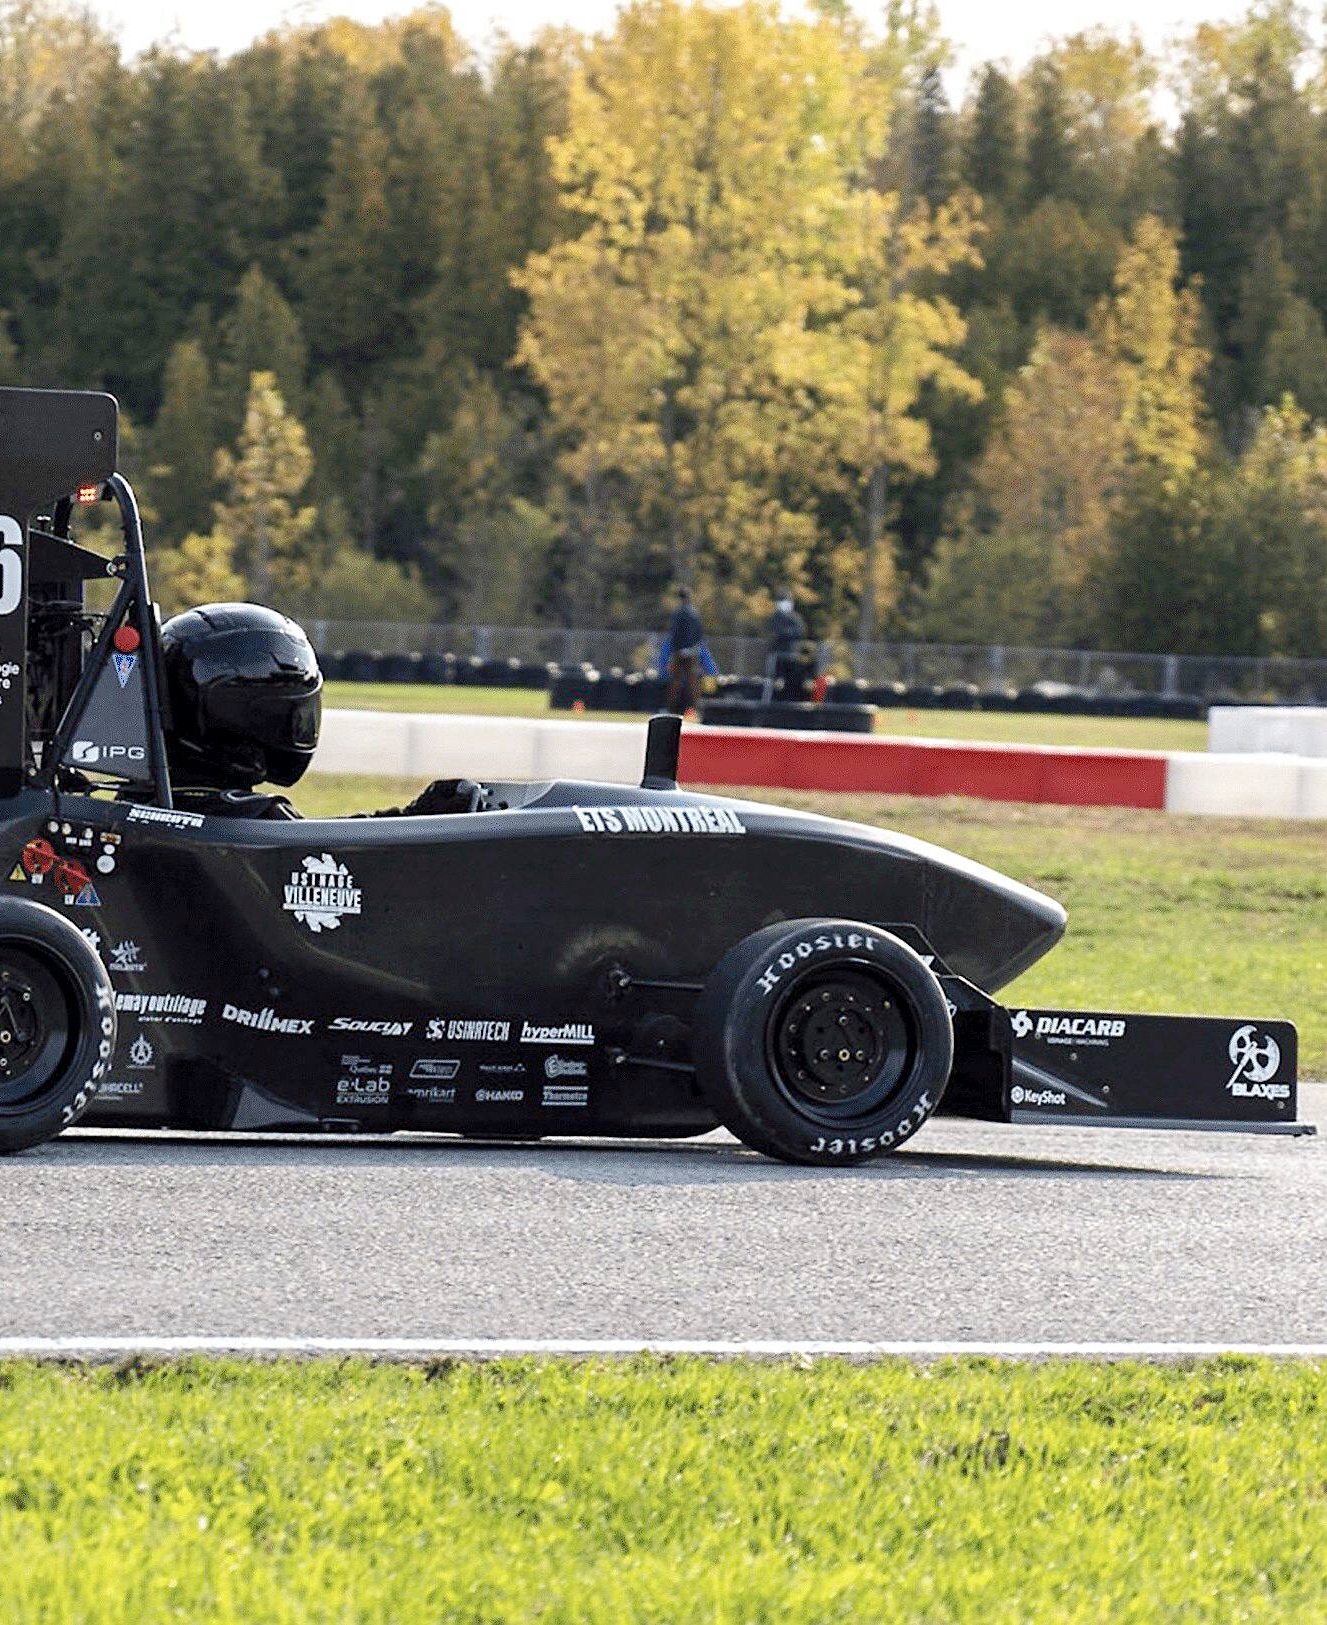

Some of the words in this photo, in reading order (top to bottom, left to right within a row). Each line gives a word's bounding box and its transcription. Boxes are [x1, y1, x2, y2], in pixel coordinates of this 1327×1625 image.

[103, 745, 146, 760] IPG
[291, 872, 354, 889] USINAGE
[284, 885, 362, 908] VILLENEUVE
[756, 932, 880, 997] Hoosier
[521, 1020, 596, 1041] hyperMILL
[1036, 1016, 1126, 1037] DIACARB
[1025, 1088, 1066, 1106] KeyShot
